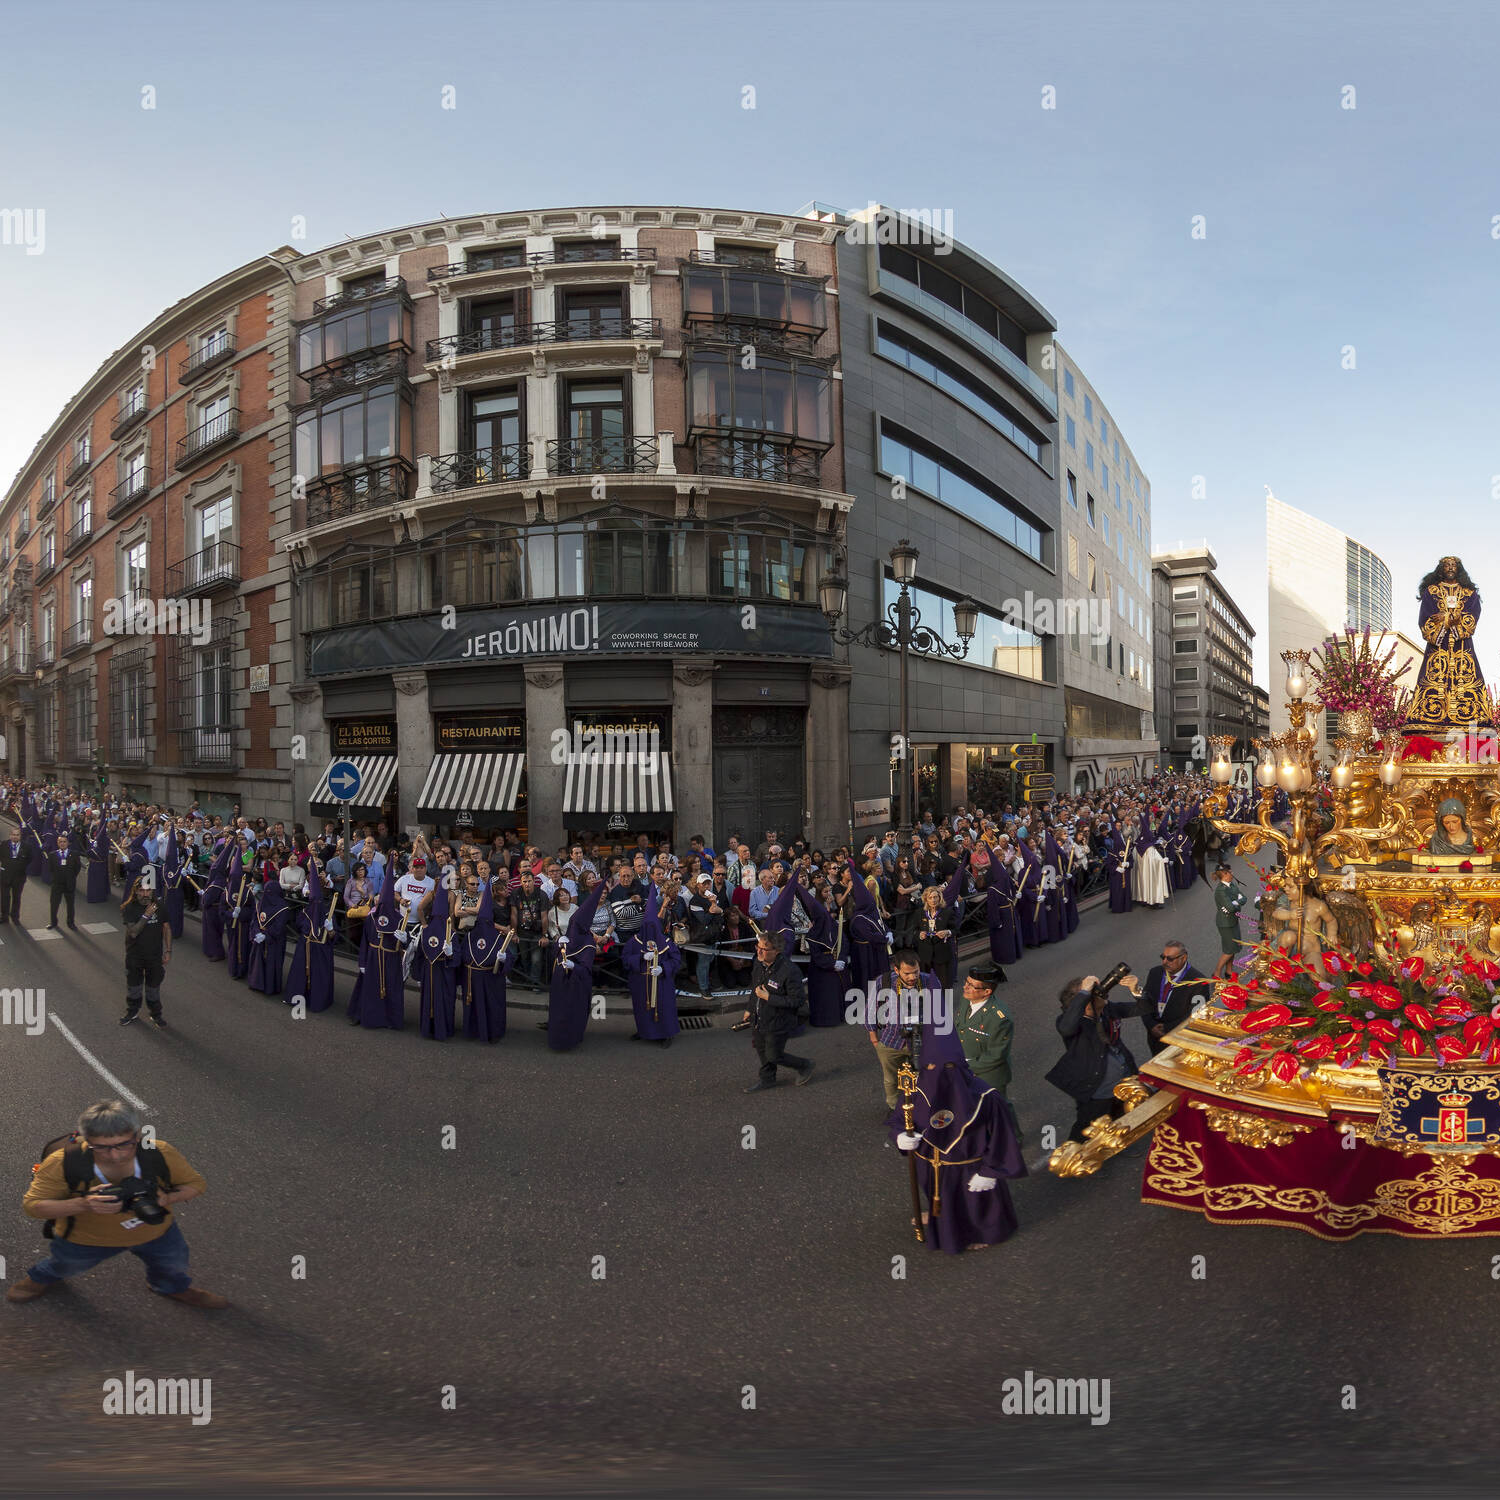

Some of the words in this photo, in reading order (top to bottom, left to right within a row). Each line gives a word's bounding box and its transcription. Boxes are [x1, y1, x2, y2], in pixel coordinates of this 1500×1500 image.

[462, 605, 599, 657] JERÓNIMO!
[611, 632, 659, 640] COWORKING
[663, 632, 688, 640] SPACE
[689, 632, 699, 640] BY
[611, 640, 699, 649] WWW.THETRIBE.WORK
[338, 726, 351, 737] EL
[352, 725, 392, 737] BARRIL
[441, 726, 521, 738] RESTAURANTE
[338, 737, 348, 745] DE
[349, 736, 363, 745] LAS
[363, 736, 391, 745] CORTES
